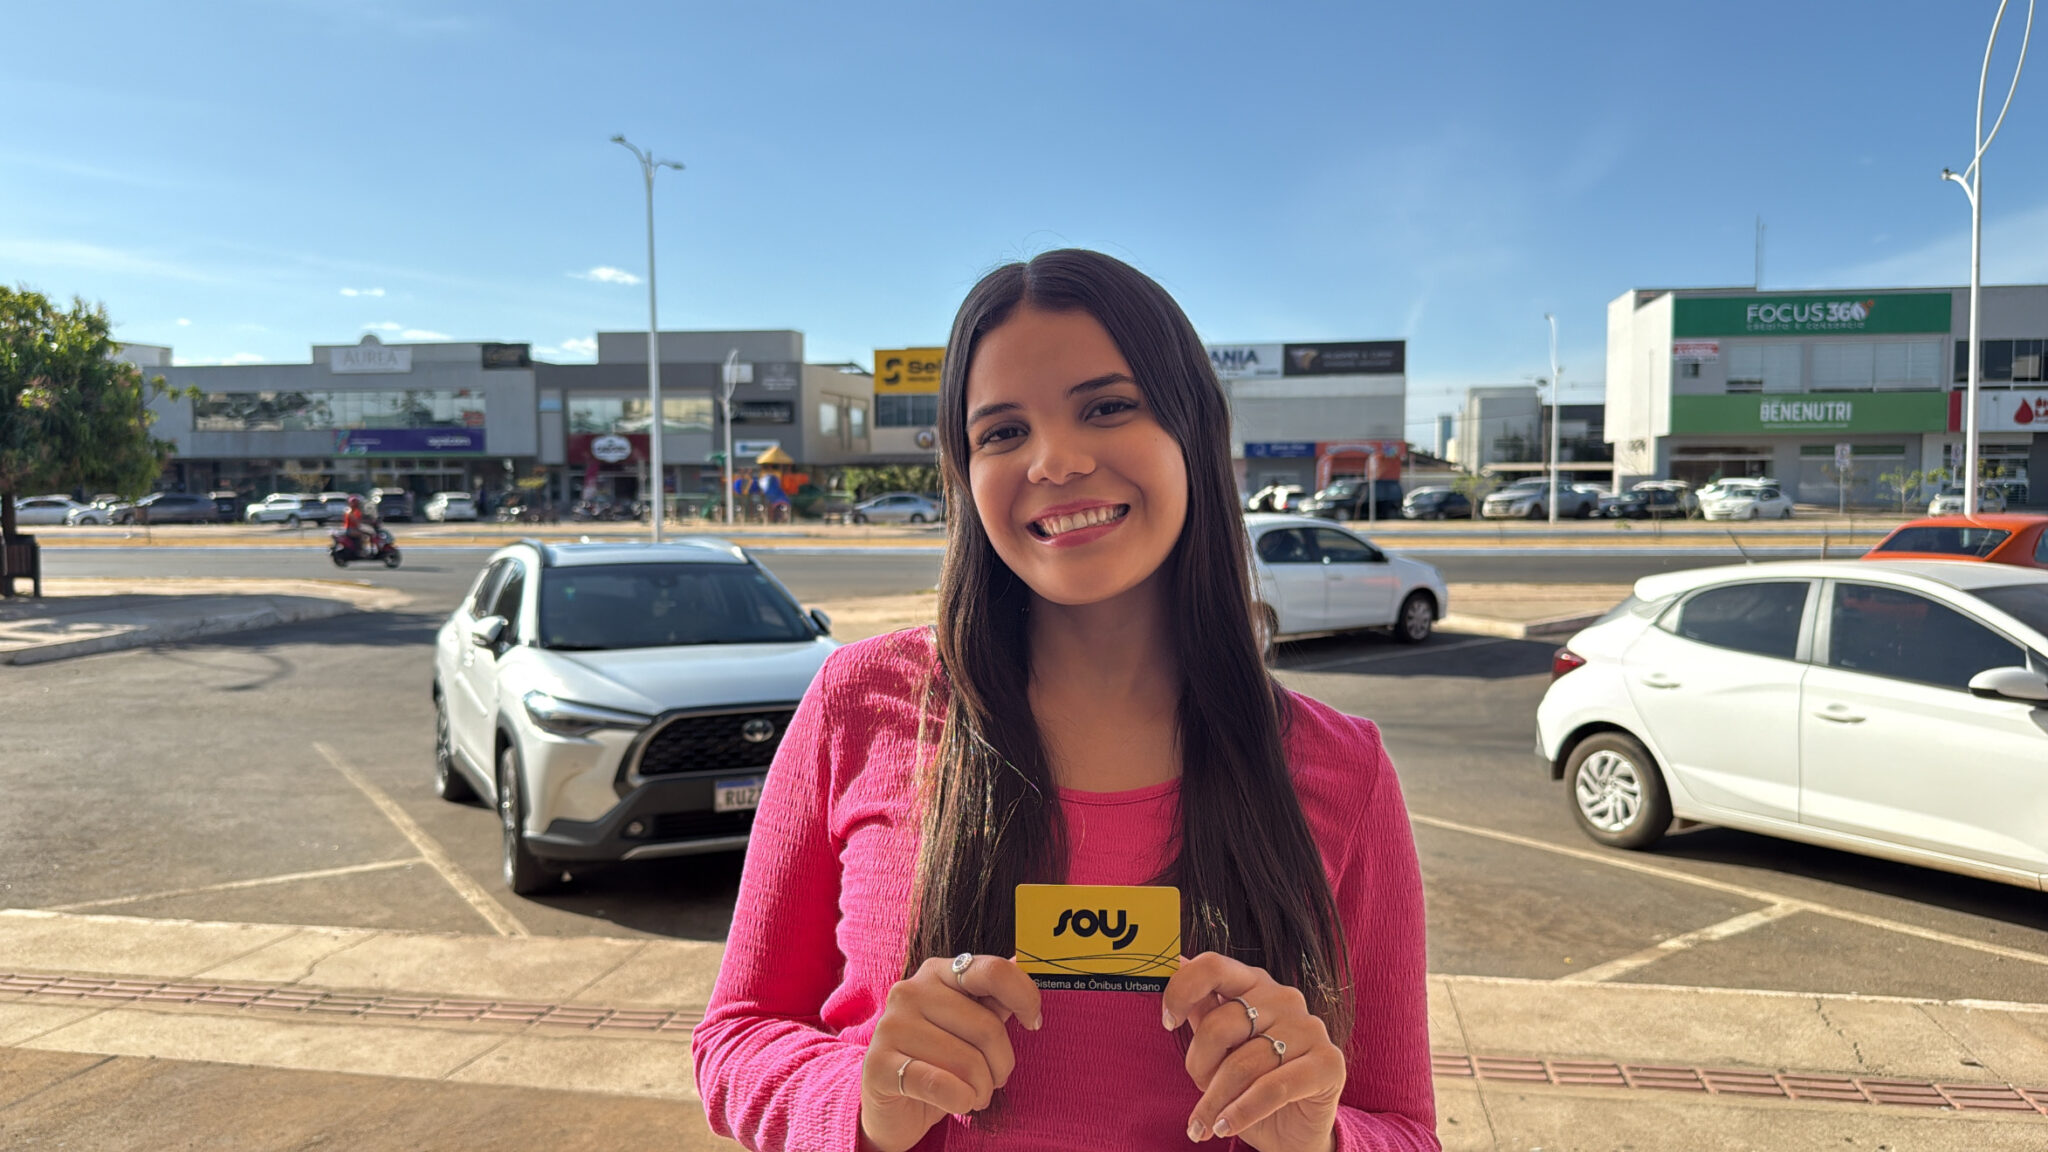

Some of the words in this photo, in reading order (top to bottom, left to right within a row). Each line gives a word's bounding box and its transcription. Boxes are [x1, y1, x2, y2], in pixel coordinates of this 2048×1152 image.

[1747, 303, 1824, 322] FOCUS
[1760, 401, 1852, 421] BENENUTRI
[1033, 979, 1071, 990] Sistema
[1073, 980, 1086, 990] de
[1088, 978, 1122, 991] Ônibus
[1125, 981, 1160, 992] Urbano
